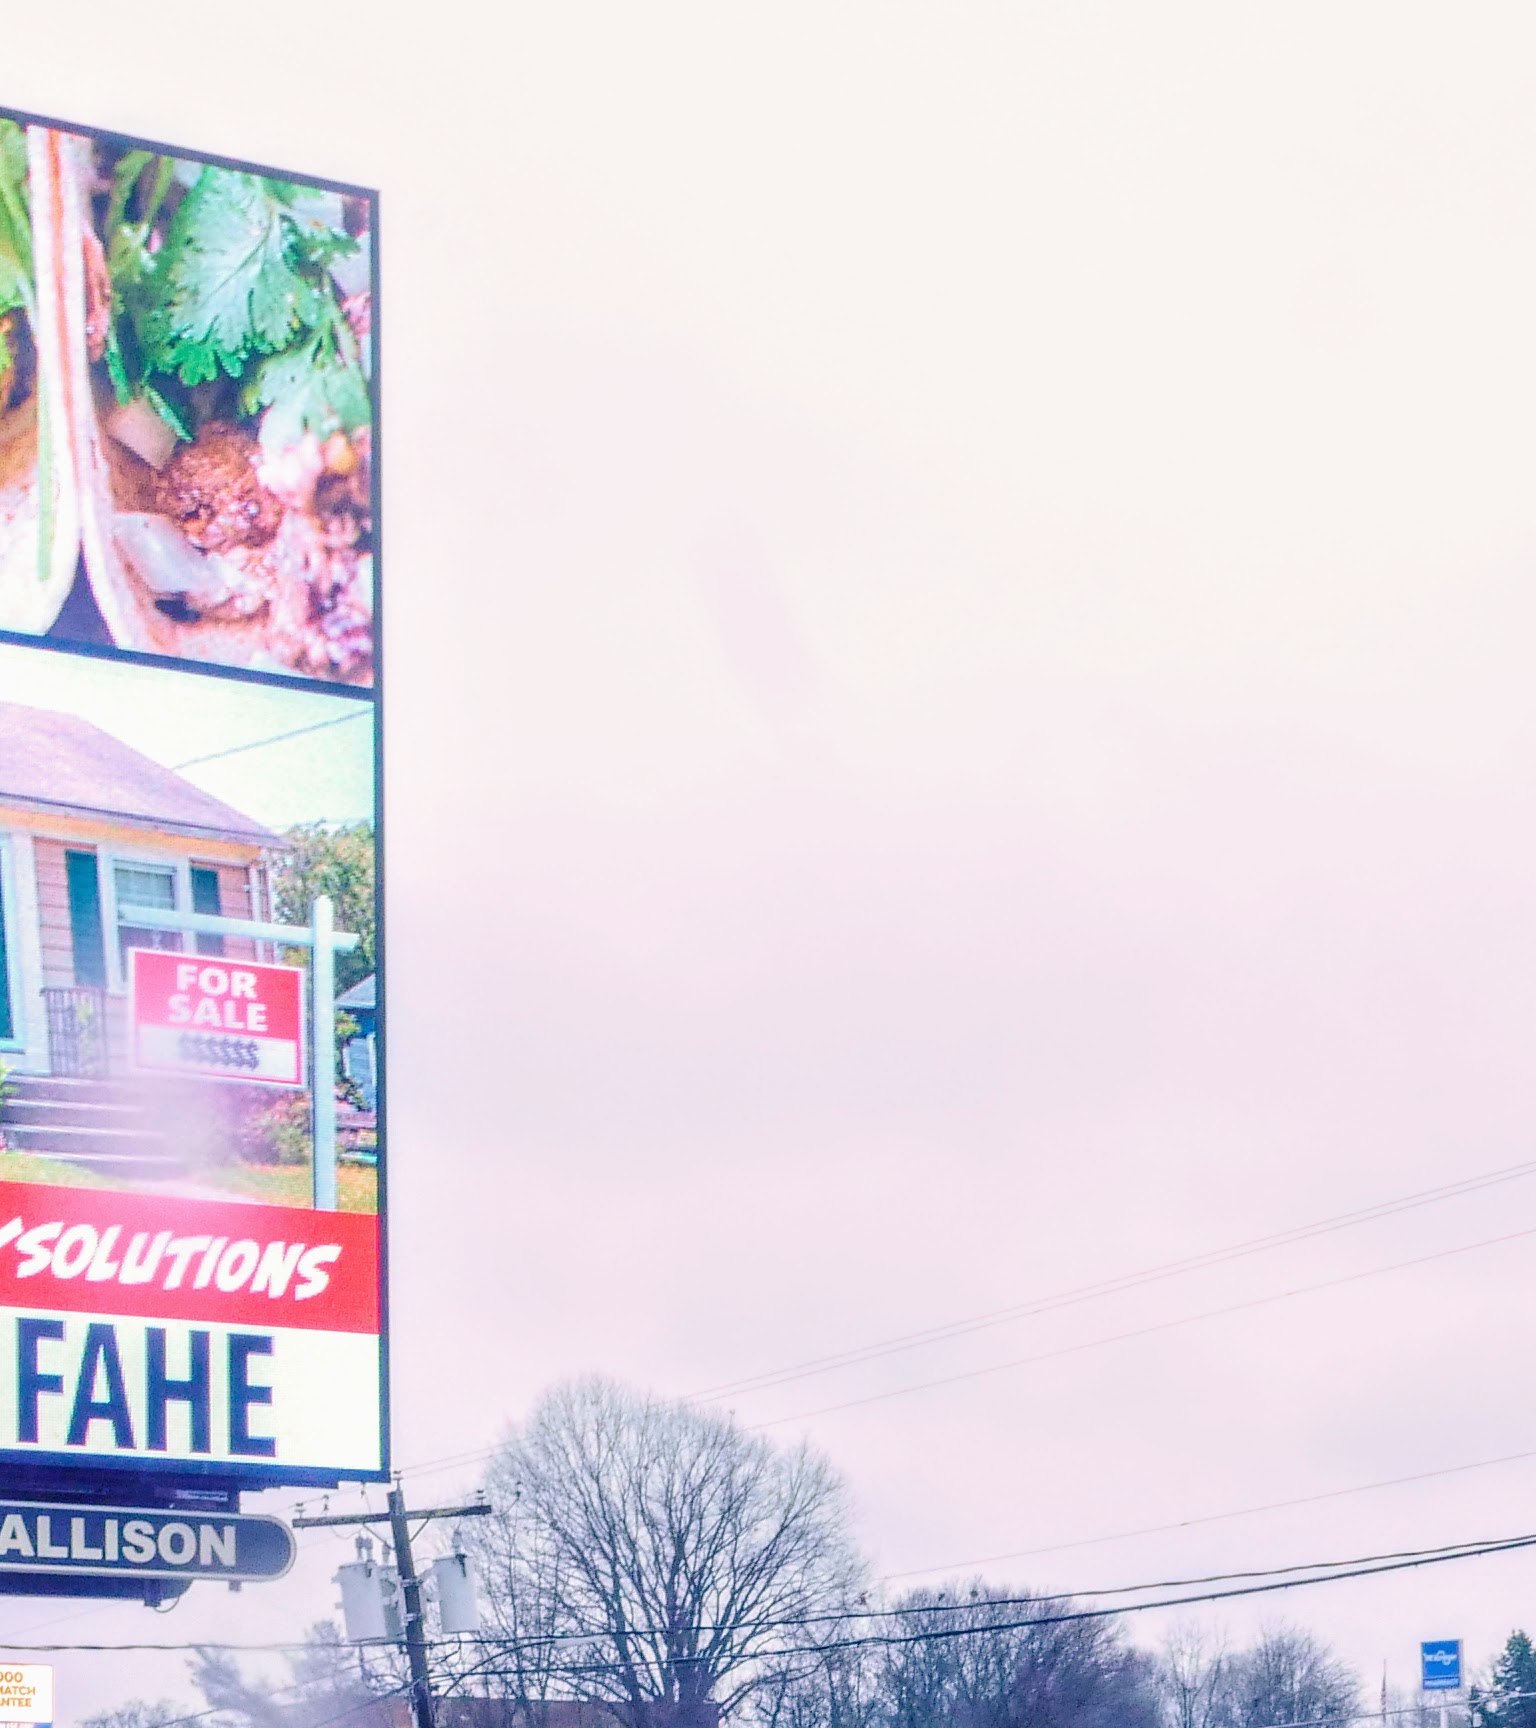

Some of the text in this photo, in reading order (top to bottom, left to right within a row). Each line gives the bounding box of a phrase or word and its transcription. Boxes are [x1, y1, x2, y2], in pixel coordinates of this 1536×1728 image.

[175, 963, 258, 999] FOR
[167, 993, 269, 1032] SALE
[15, 1316, 277, 1458] FAHE
